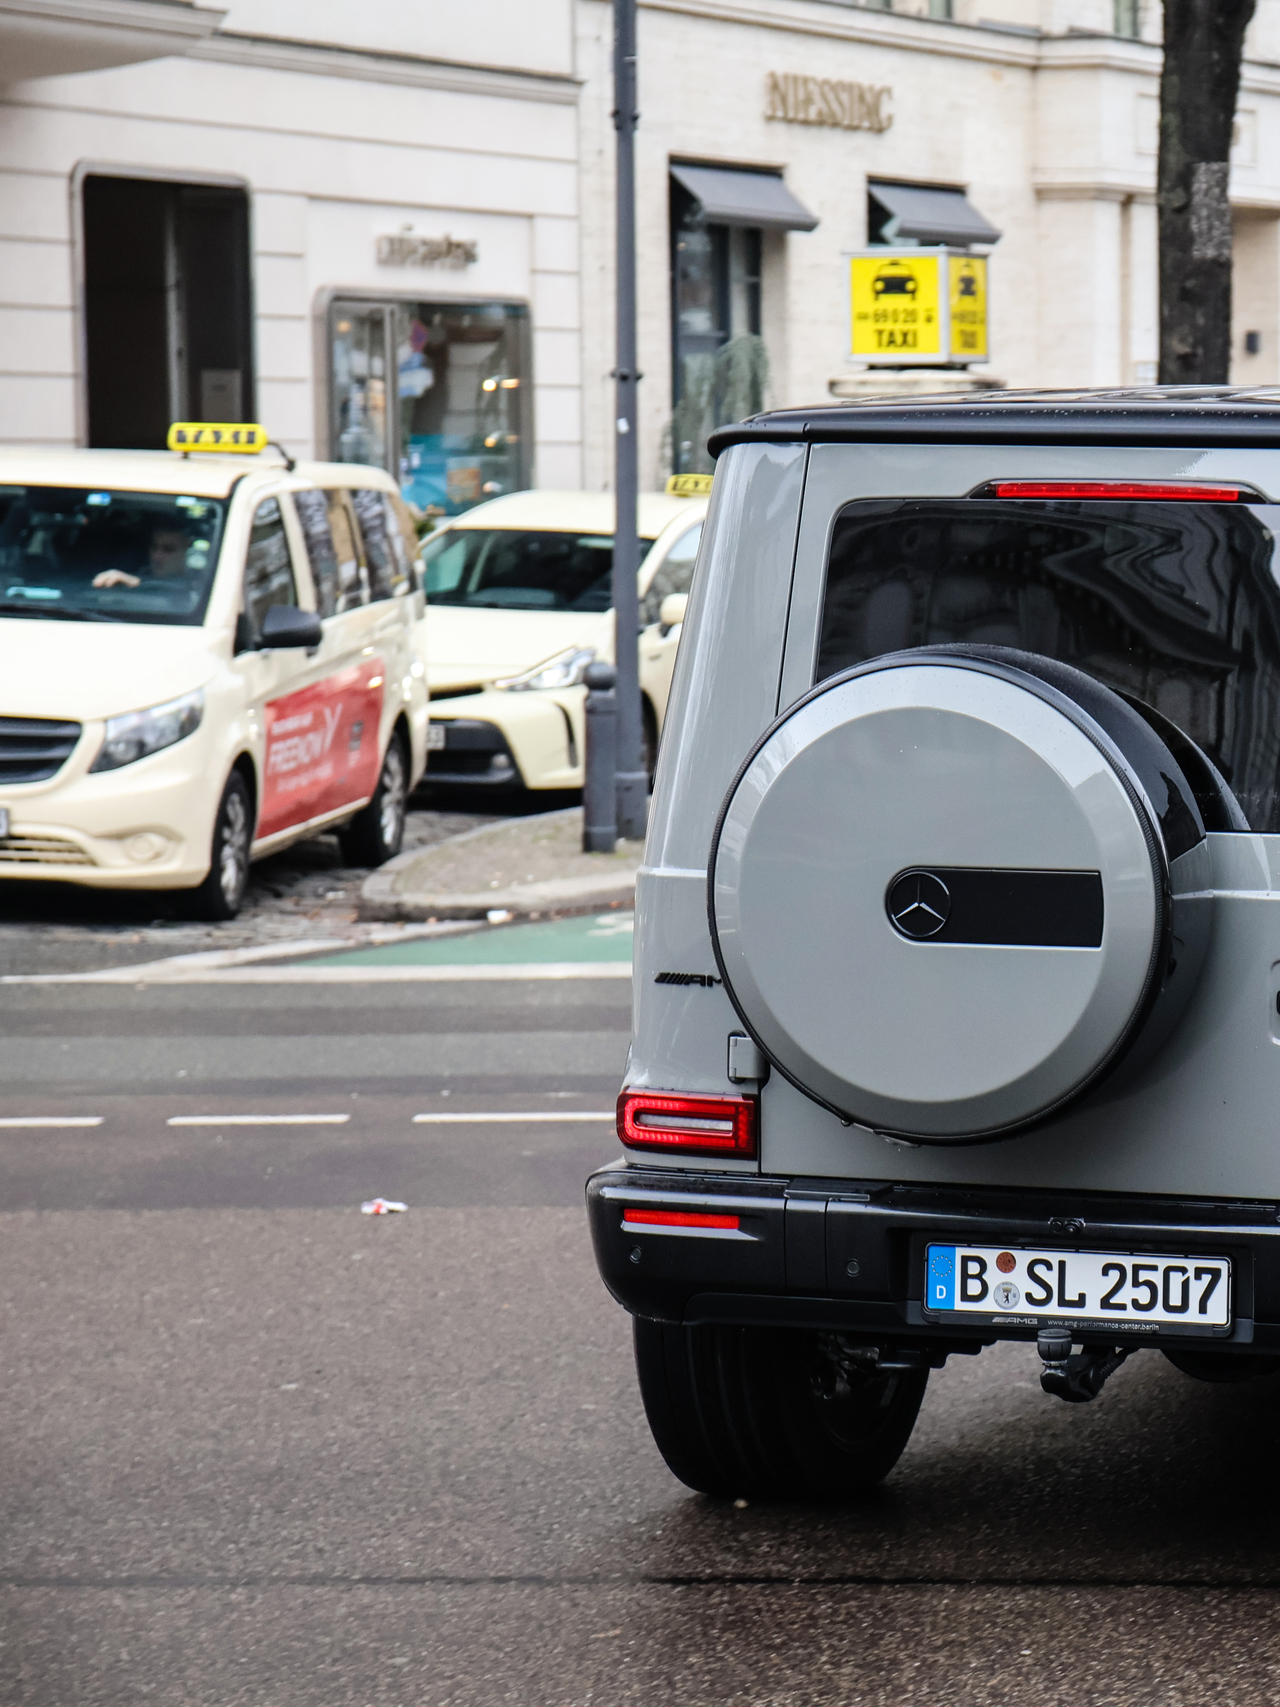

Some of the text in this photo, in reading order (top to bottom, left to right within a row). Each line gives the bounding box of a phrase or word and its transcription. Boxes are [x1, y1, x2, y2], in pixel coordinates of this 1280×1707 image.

[875, 329, 918, 348] TAXI
[176, 427, 257, 445] TAXI
[682, 972, 722, 988] AM
[936, 1285, 947, 1299] D
[960, 1254, 989, 1302] B
[1025, 1257, 1087, 1309] SL
[1100, 1262, 1222, 1315] 2507
[1005, 1316, 1160, 1331] AMG www.amg-performance-center.berlin
